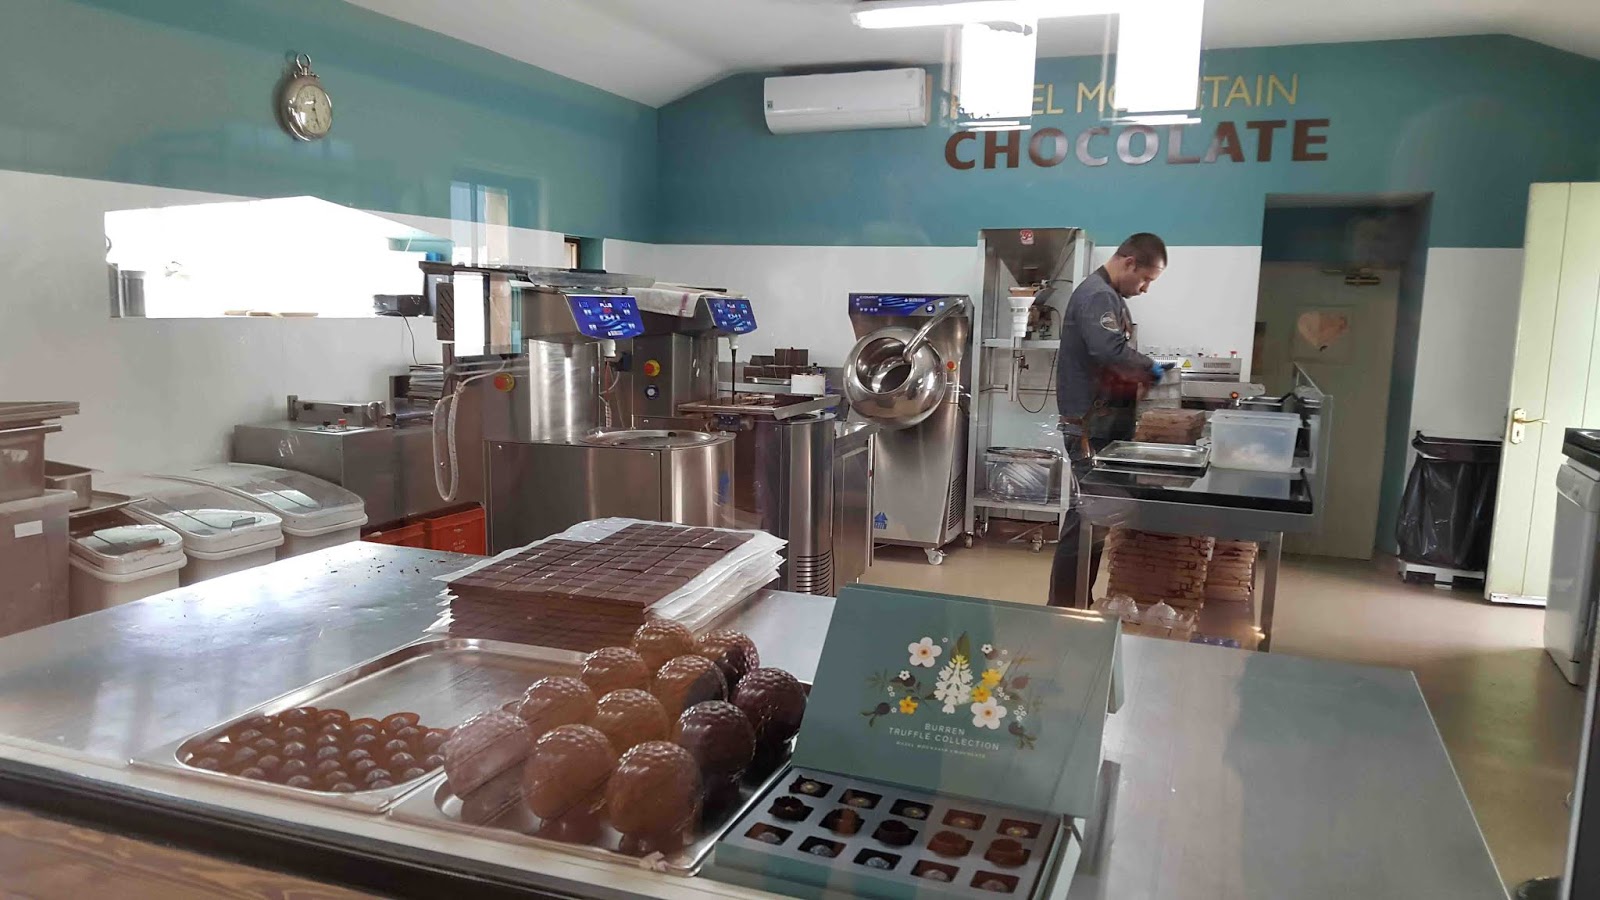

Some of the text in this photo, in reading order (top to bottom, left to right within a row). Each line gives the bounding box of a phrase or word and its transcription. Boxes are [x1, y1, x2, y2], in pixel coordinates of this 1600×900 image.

[1076, 73, 1298, 113] MTAIN
[944, 118, 1330, 170] CHOCOLATE
[888, 727, 931, 741] TRUFFLE
[934, 734, 1000, 751] COLLECTION
[924, 723, 966, 736] BURREN
